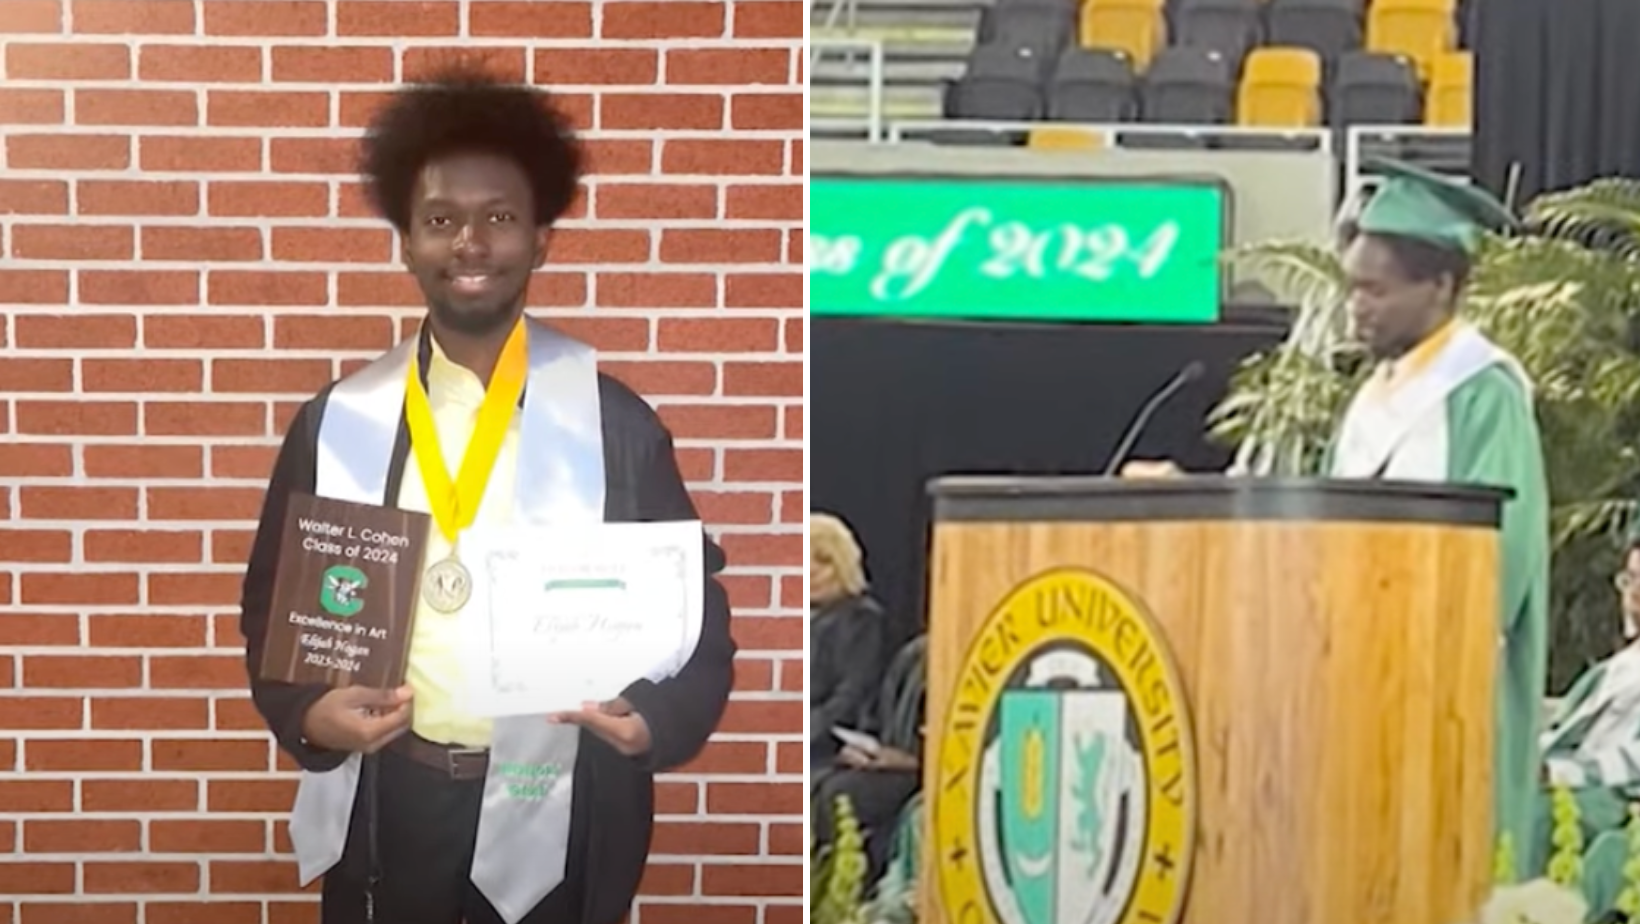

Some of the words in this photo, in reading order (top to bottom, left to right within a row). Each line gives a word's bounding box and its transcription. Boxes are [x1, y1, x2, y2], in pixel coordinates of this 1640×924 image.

[869, 205, 993, 302] of
[979, 220, 1180, 281] 2024
[298, 517, 345, 537] Walter
[360, 528, 410, 547] Cohen
[302, 537, 342, 556] Class
[344, 545, 360, 558] of
[362, 546, 399, 563] 2024
[288, 611, 353, 633] Excellence
[354, 624, 368, 636] in
[368, 627, 388, 639] Art
[944, 611, 1022, 794] XAVIER
[1035, 582, 1185, 809] UNIVERSITY
